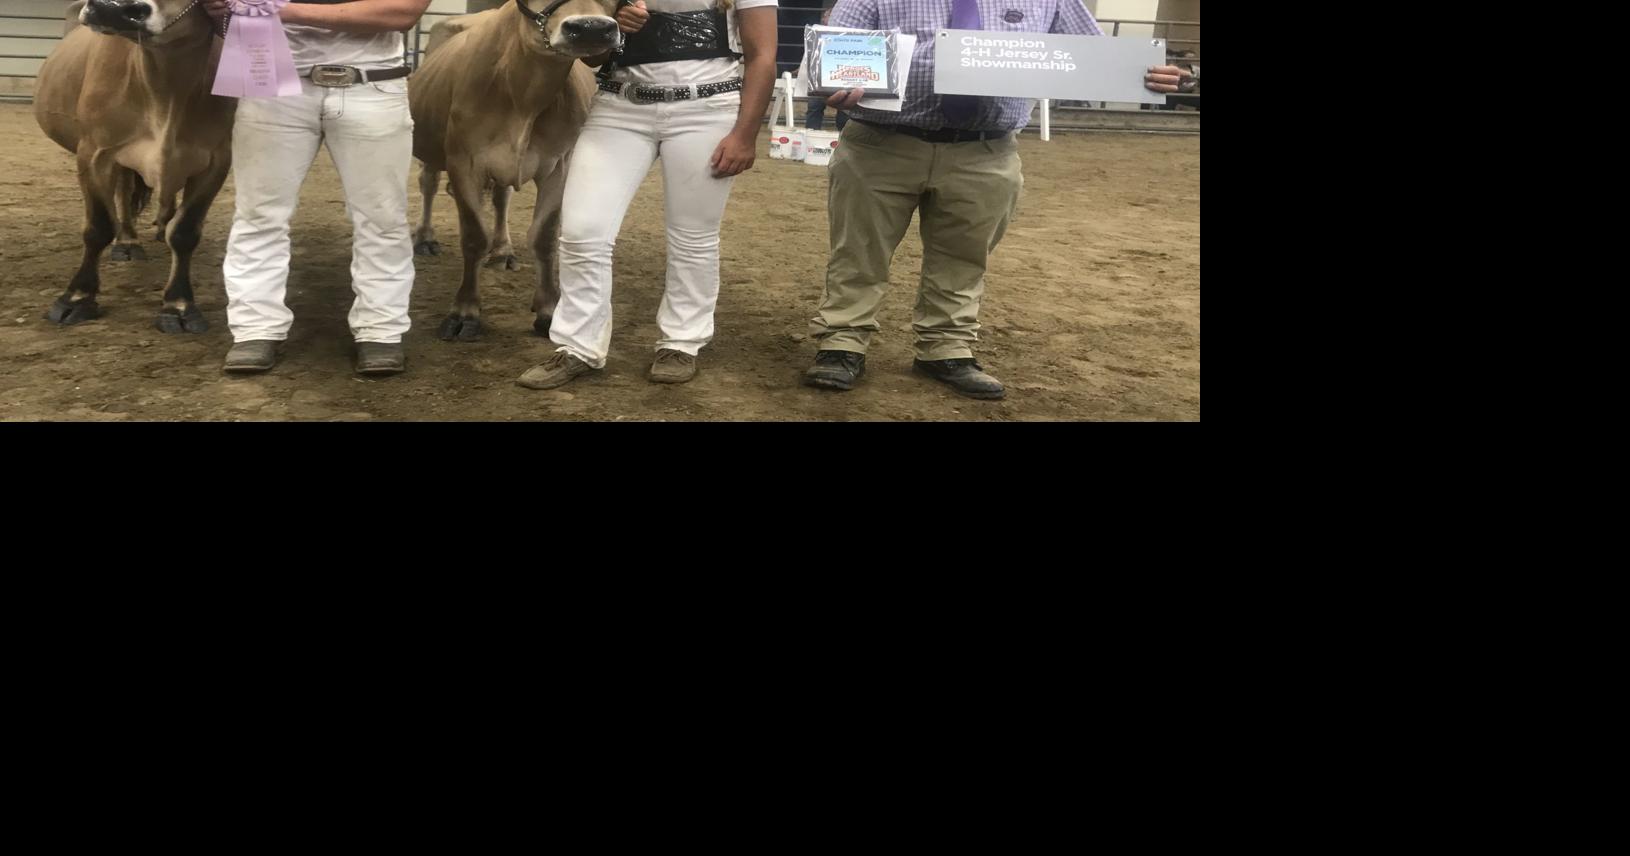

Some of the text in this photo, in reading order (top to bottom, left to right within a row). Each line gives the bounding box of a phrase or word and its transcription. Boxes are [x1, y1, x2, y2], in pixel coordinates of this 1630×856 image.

[960, 36, 1045, 49] Champion
[960, 47, 1073, 60] 4-H Jersey Sr.
[960, 57, 1077, 72] Showmanship
